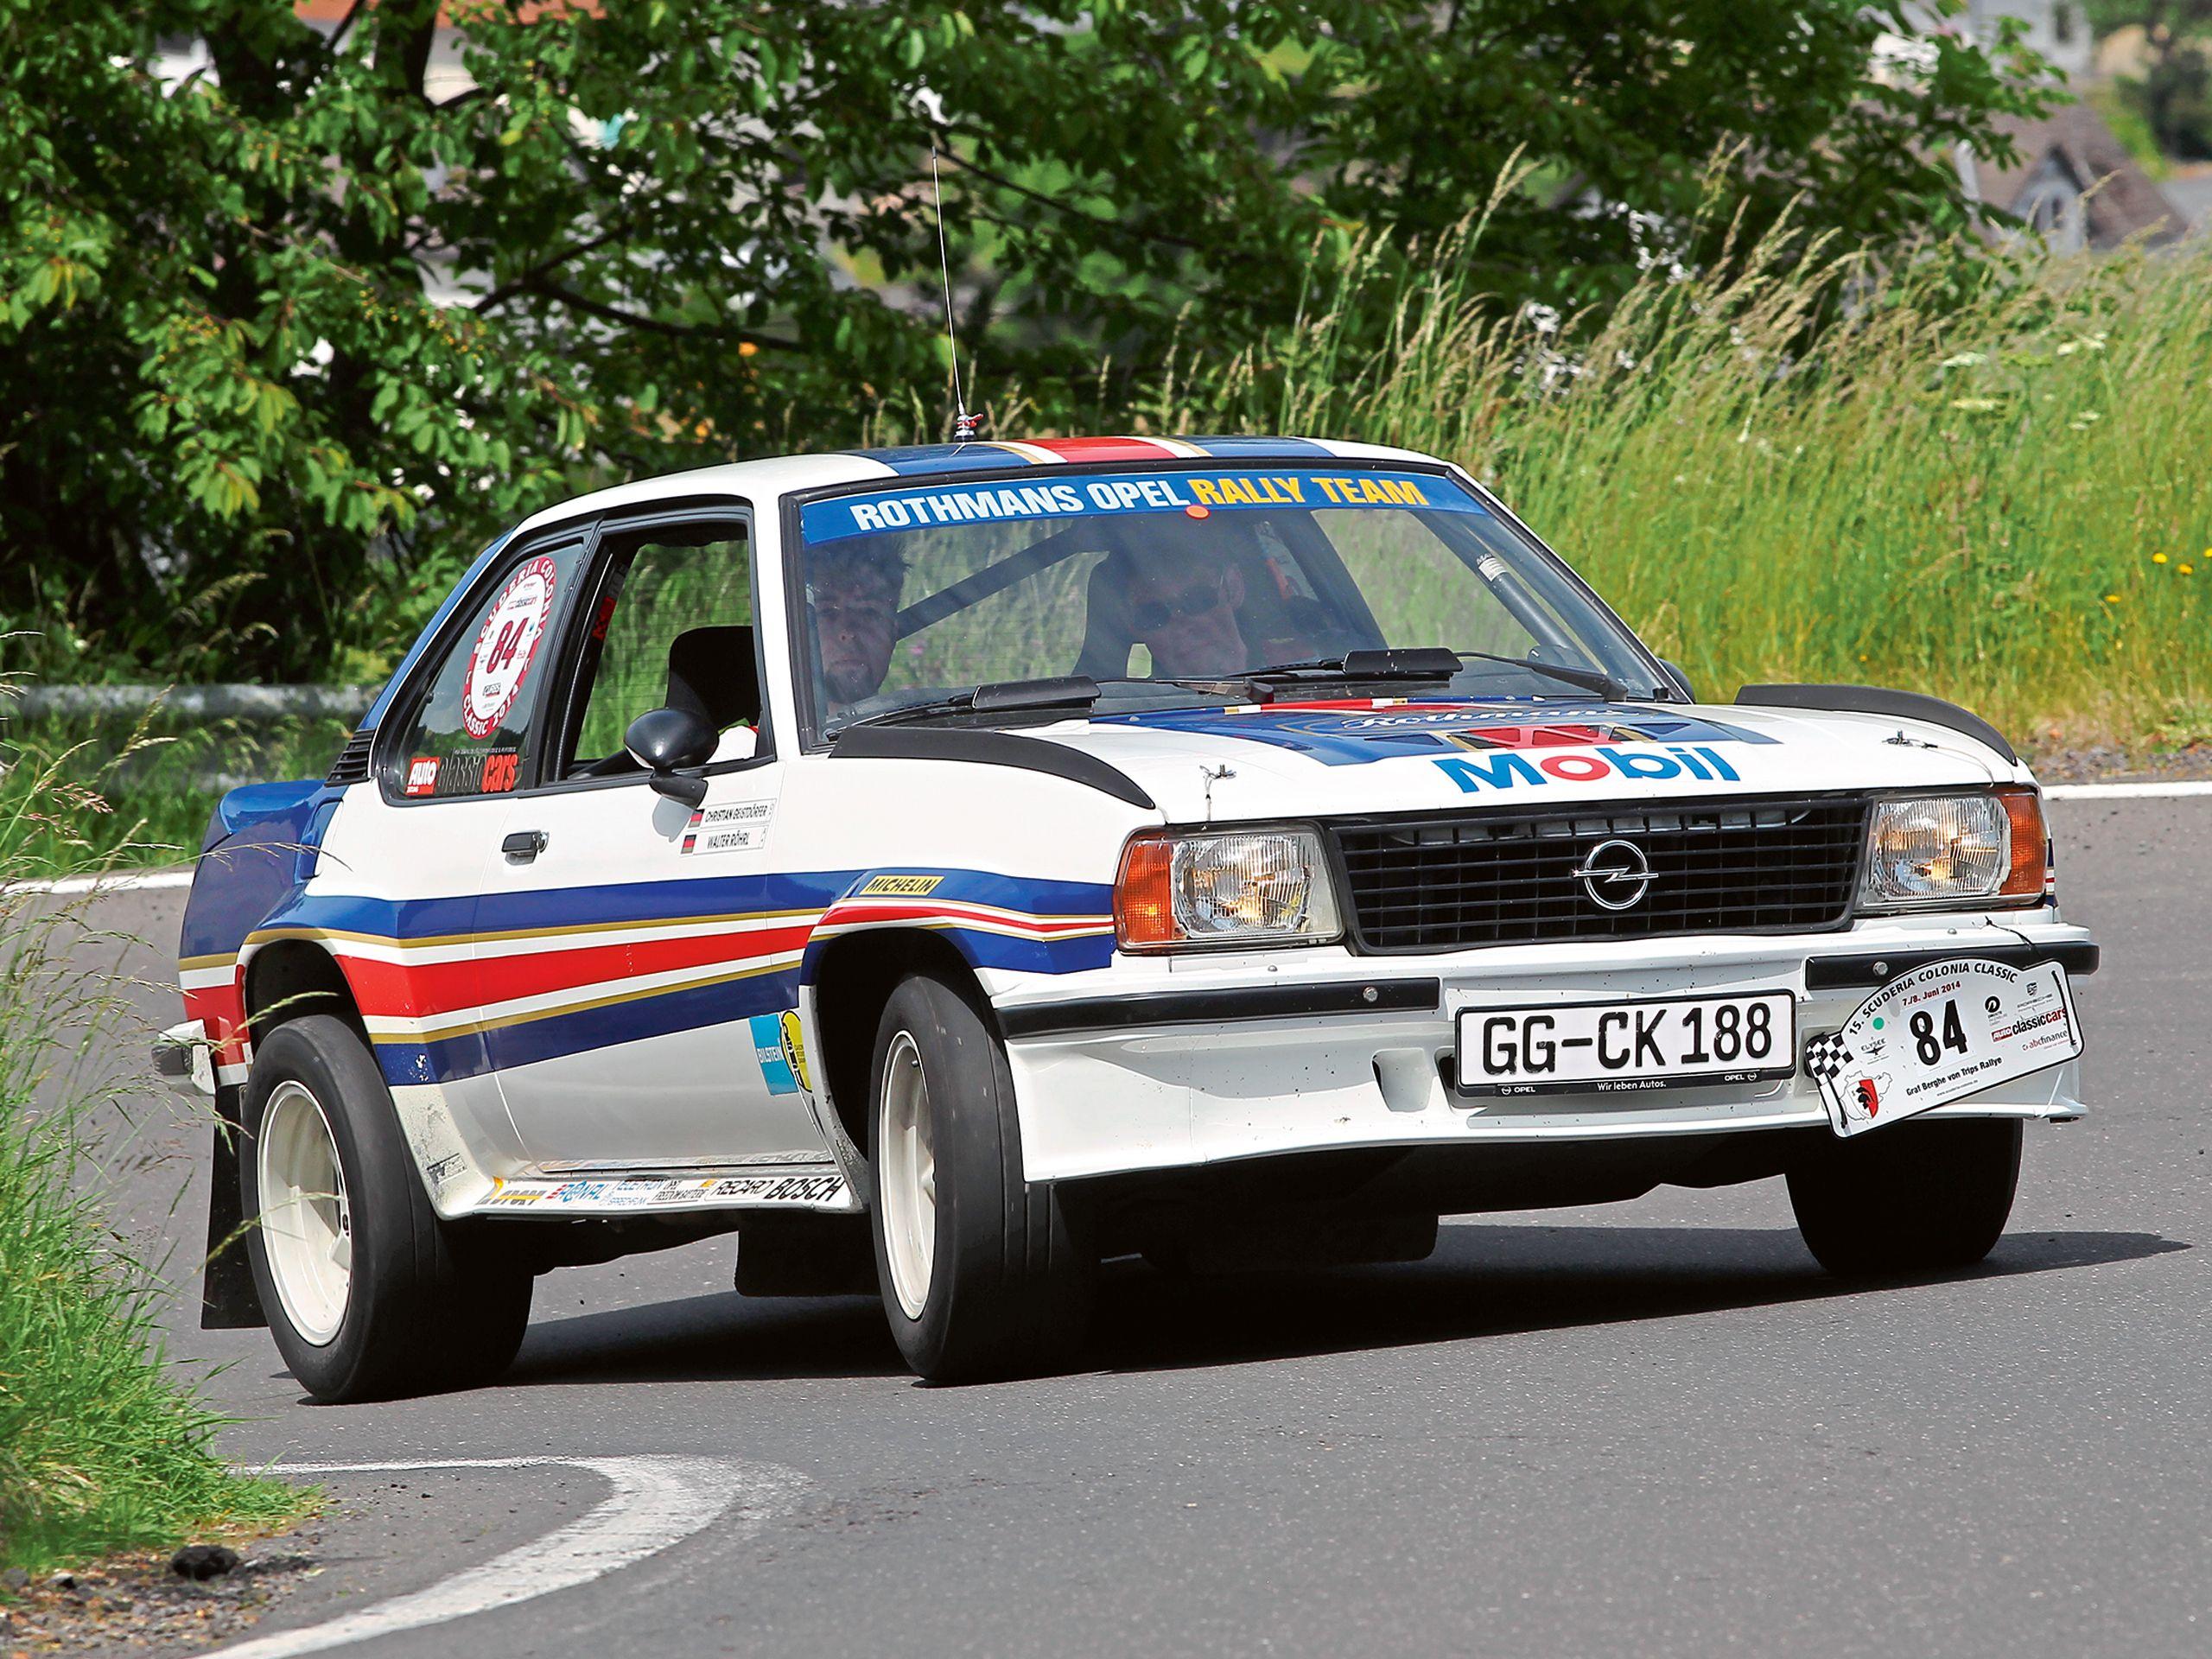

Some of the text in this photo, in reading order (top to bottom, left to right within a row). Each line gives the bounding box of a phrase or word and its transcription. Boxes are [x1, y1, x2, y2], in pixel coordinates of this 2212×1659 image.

[849, 477, 1429, 531] ROTHMANS OPEL RALLY TEAM
[486, 618, 530, 674] 84
[463, 694, 488, 735] CLASSIC
[1431, 747, 1740, 793] Mobil
[707, 834, 730, 849] WALTER
[865, 878, 938, 892] MICHELIN
[1849, 963, 2018, 1036] 15. SCUDERIA COLONIA CLASSIC
[1923, 988, 1940, 1000] Juni
[1942, 981, 1961, 993] 2014
[1681, 1002, 1771, 1065] 188
[1910, 999, 1968, 1066] 84
[1514, 1085, 1535, 1094] OPEL
[1598, 1079, 1666, 1091] Wir leben Autos.
[1906, 1057, 2003, 1096] Graf Berghe von Trips Rallye
[713, 1179, 774, 1196] RECARO
[764, 1177, 845, 1202] BOSCH
